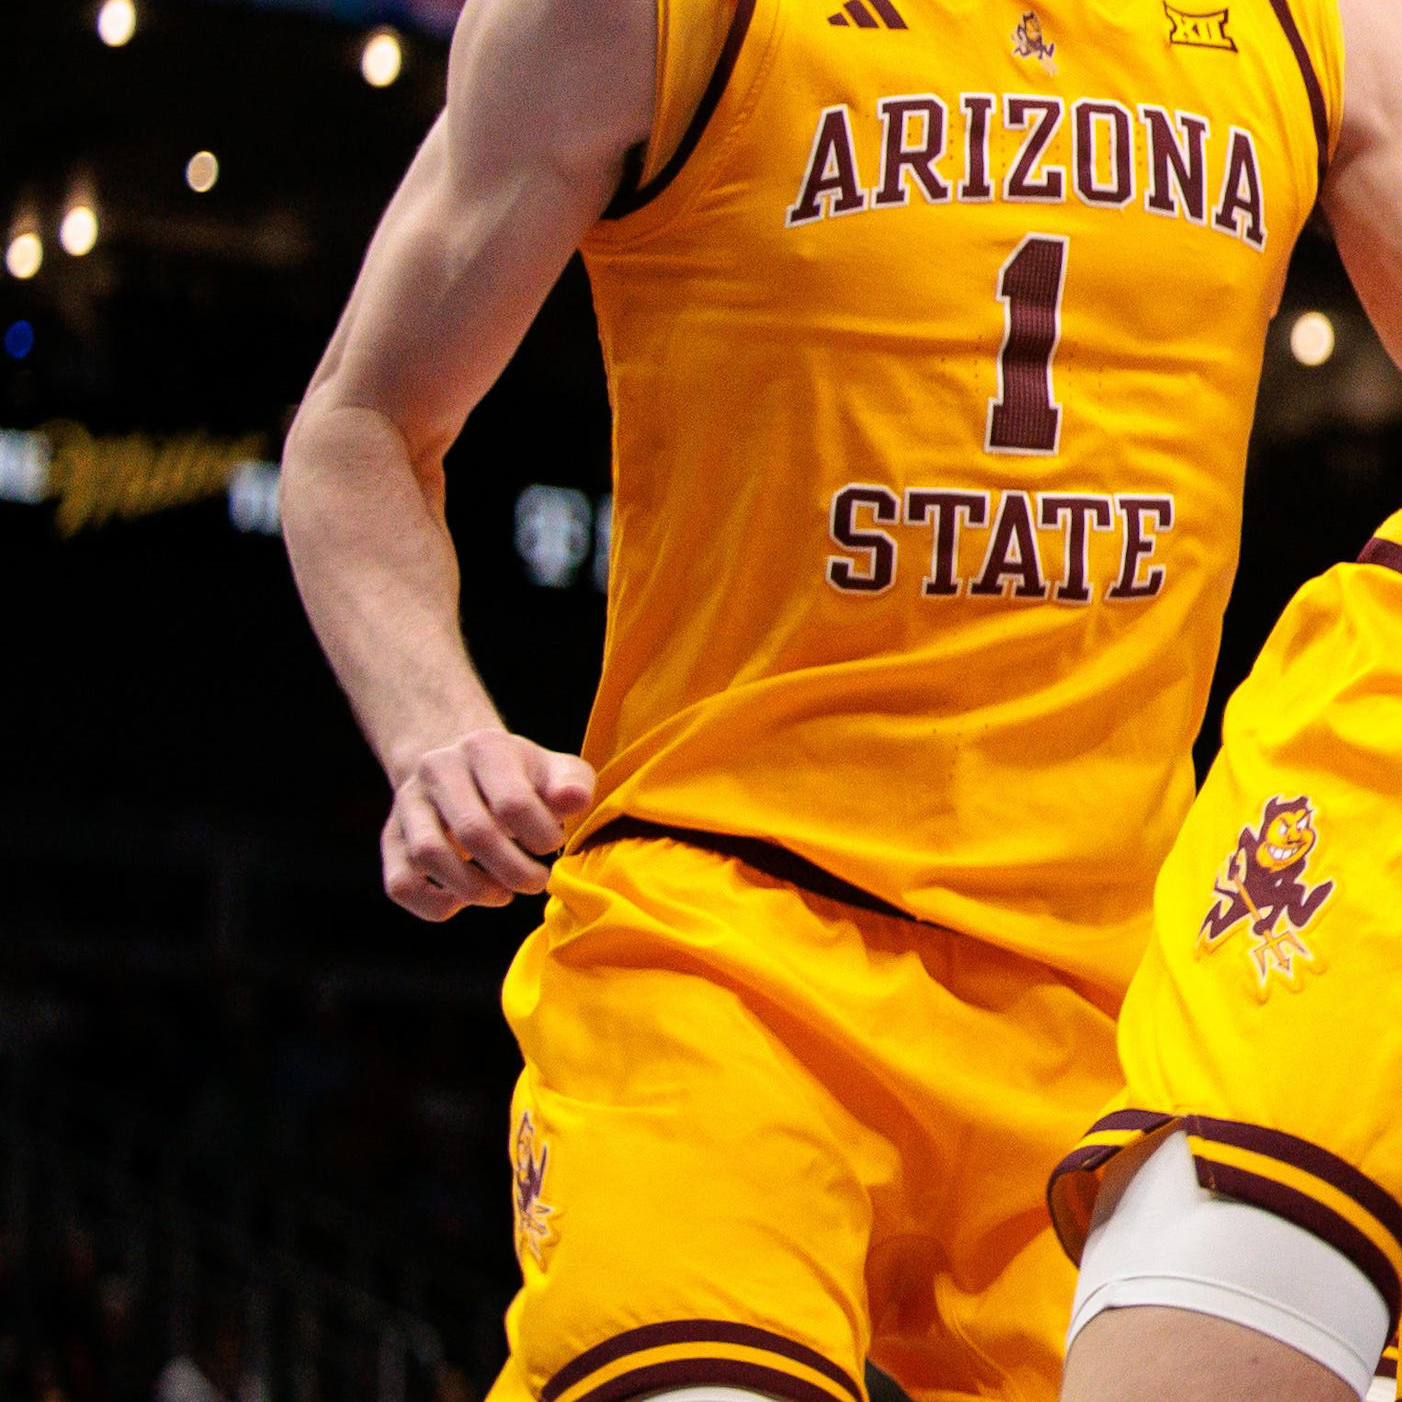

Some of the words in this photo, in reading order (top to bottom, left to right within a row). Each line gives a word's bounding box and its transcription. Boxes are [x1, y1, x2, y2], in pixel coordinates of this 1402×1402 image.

[785, 92, 1267, 252] ARIZONA
[983, 232, 1070, 456] 1
[826, 482, 1174, 605] STATE
